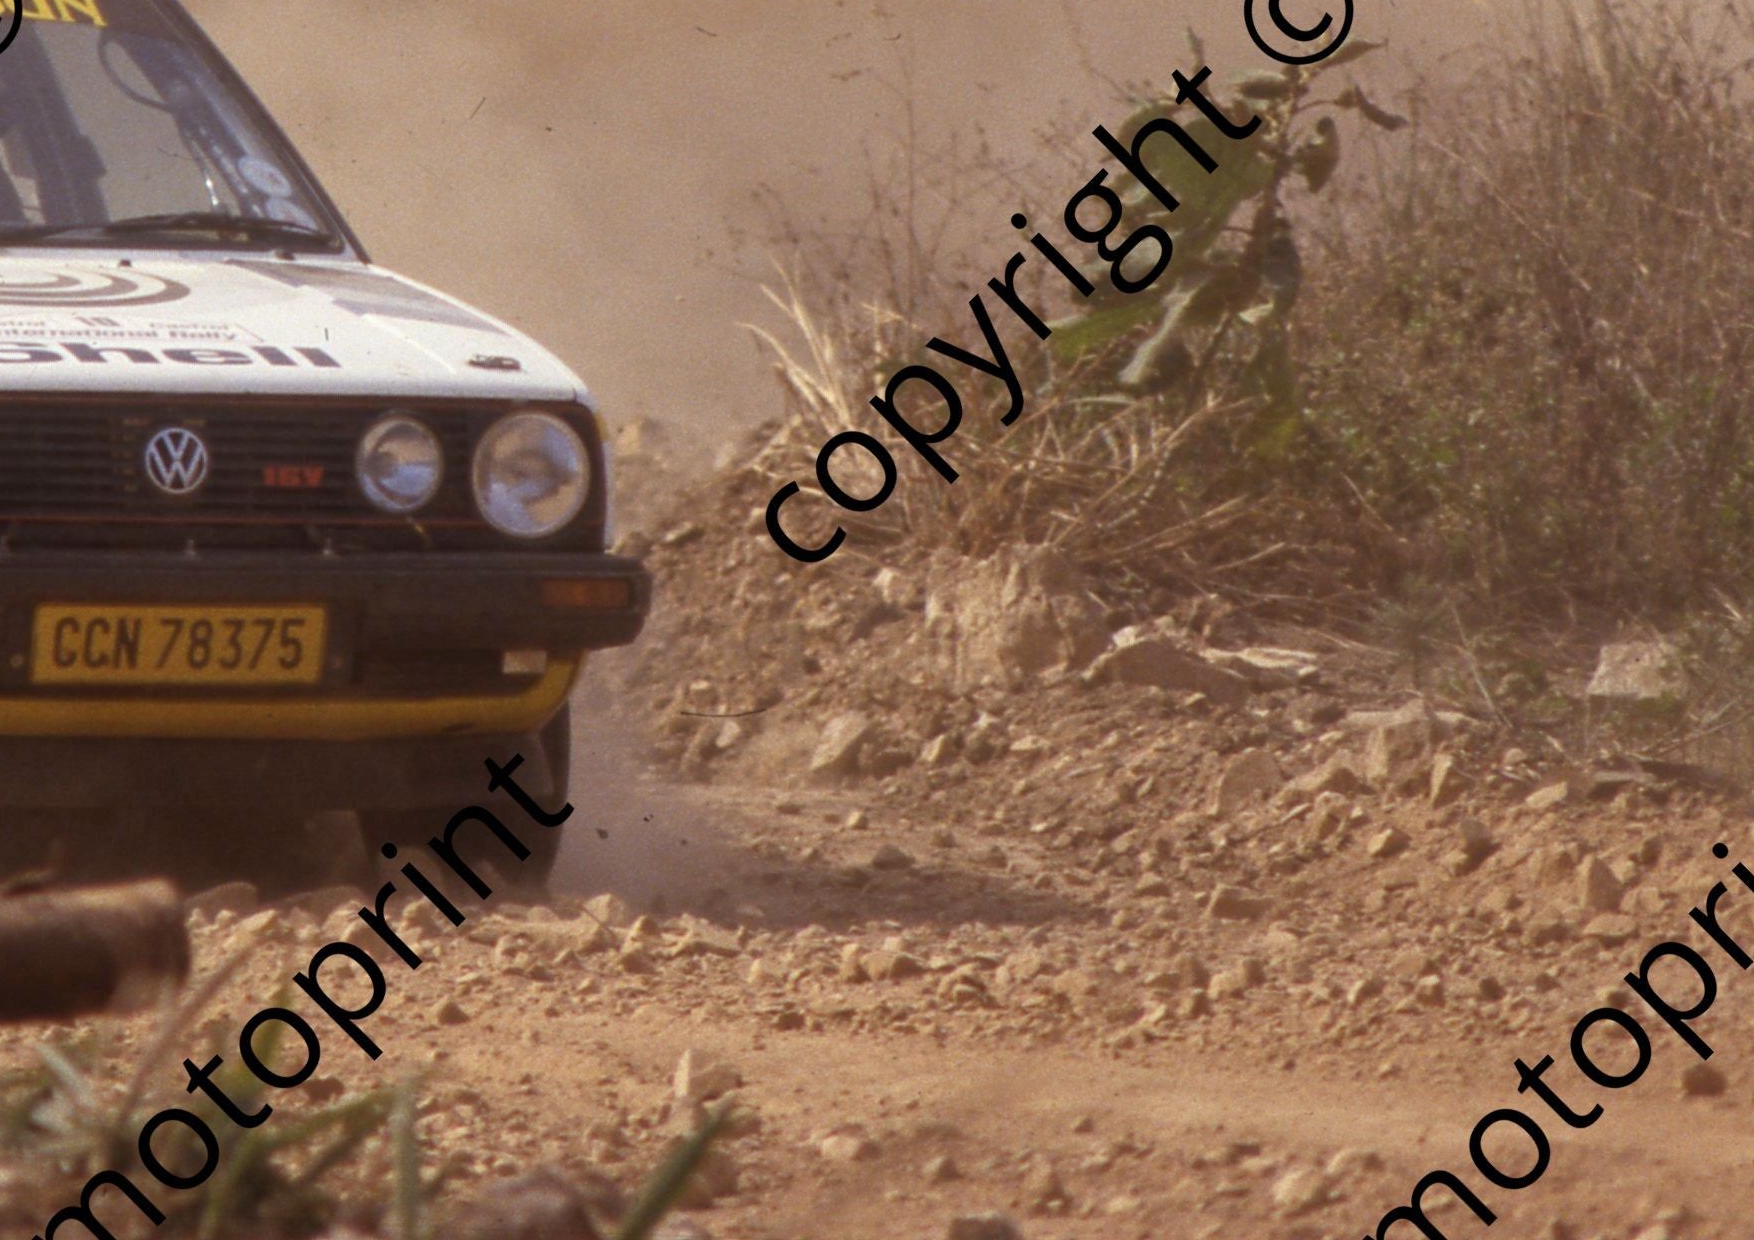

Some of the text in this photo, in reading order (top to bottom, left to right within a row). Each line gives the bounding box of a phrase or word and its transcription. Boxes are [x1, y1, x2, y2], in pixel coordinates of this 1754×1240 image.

[168, 329, 238, 341] Rally
[53, 616, 305, 671] CCN 78375
